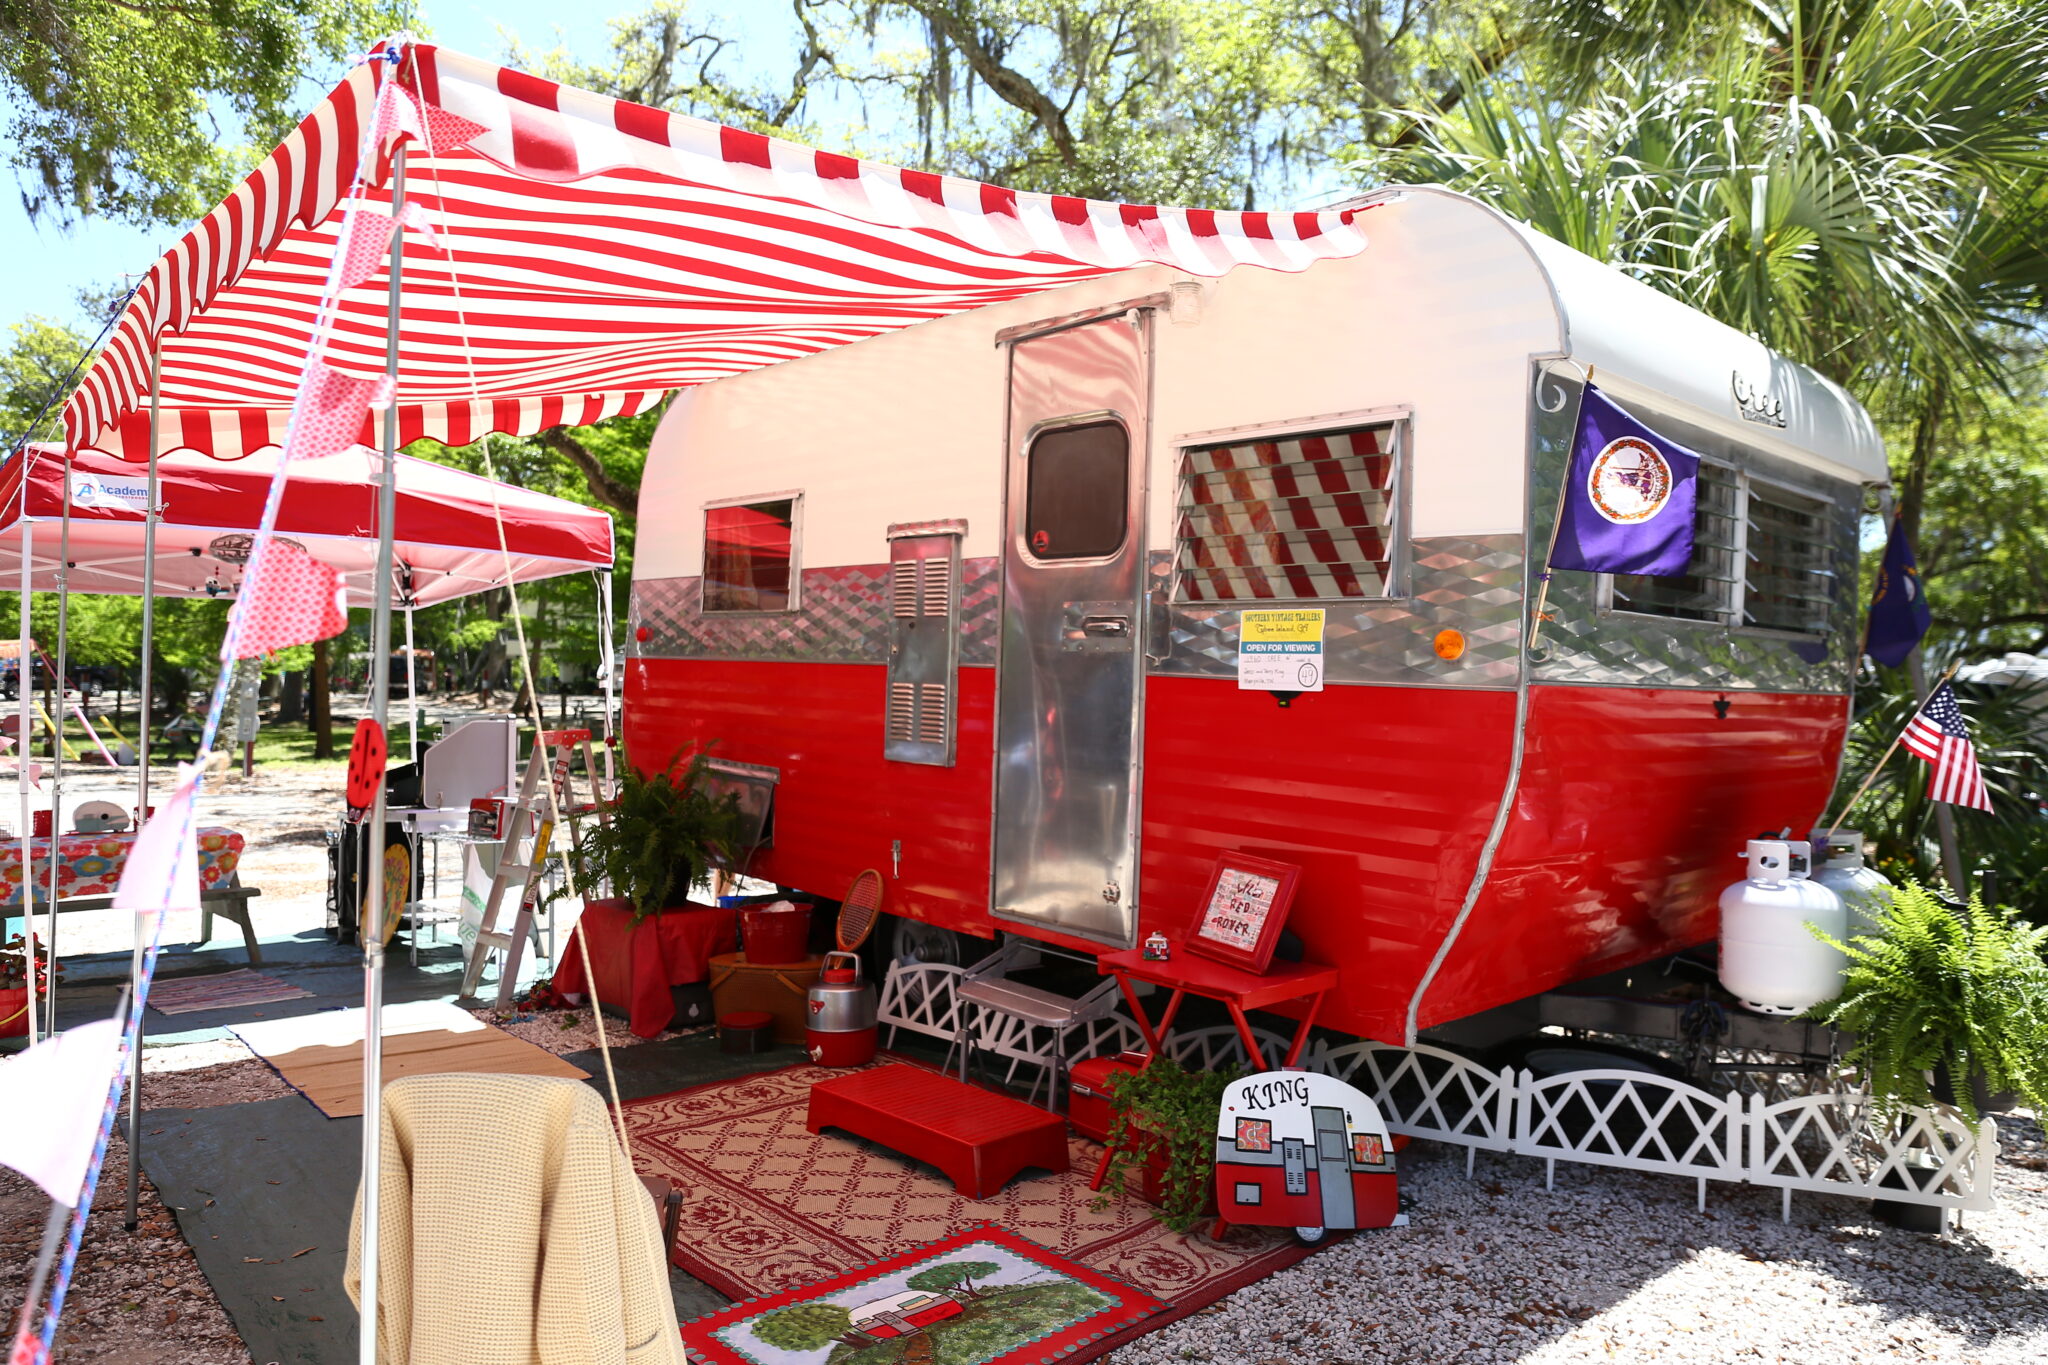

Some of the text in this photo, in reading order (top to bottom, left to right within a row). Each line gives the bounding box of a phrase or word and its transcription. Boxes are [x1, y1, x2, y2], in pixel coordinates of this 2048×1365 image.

[99, 484, 149, 497] Academ
[1245, 612, 1321, 622] SOUTHERN VINTAGE TRAILERS
[1246, 644, 1316, 652] OPEN FOR VIEWING
[1301, 669, 1314, 684] 49
[1229, 898, 1251, 914] RED
[1242, 1077, 1309, 1111] KING
